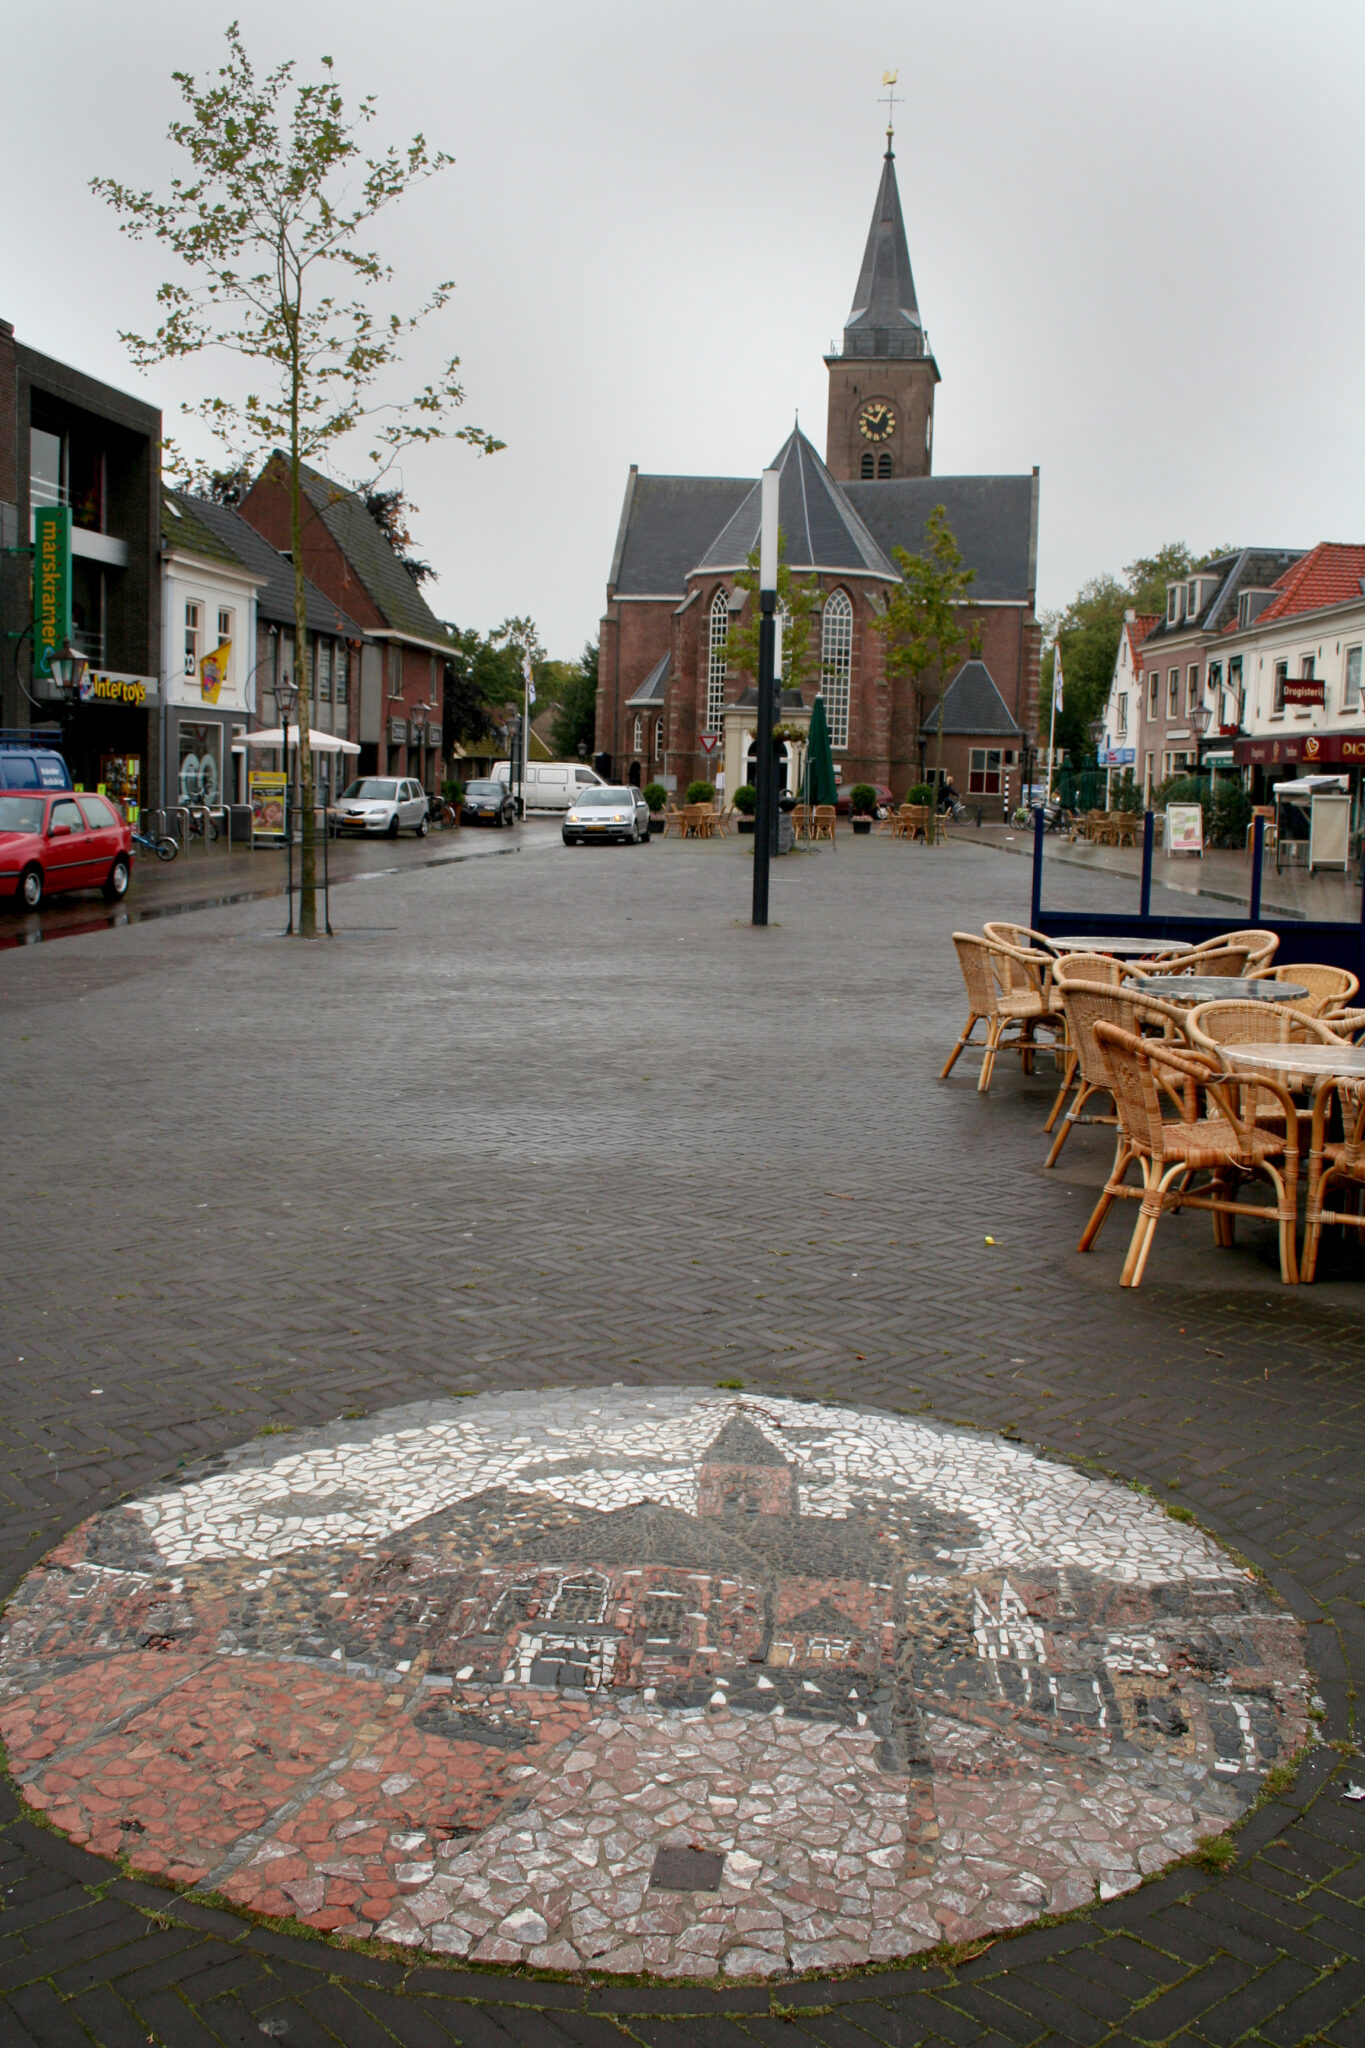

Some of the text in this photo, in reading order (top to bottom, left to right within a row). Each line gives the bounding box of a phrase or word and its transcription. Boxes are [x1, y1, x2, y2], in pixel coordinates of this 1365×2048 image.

[41, 521, 61, 647] marskramer
[93, 673, 147, 707] Intertoys
[1283, 685, 1325, 699] Drogisterij
